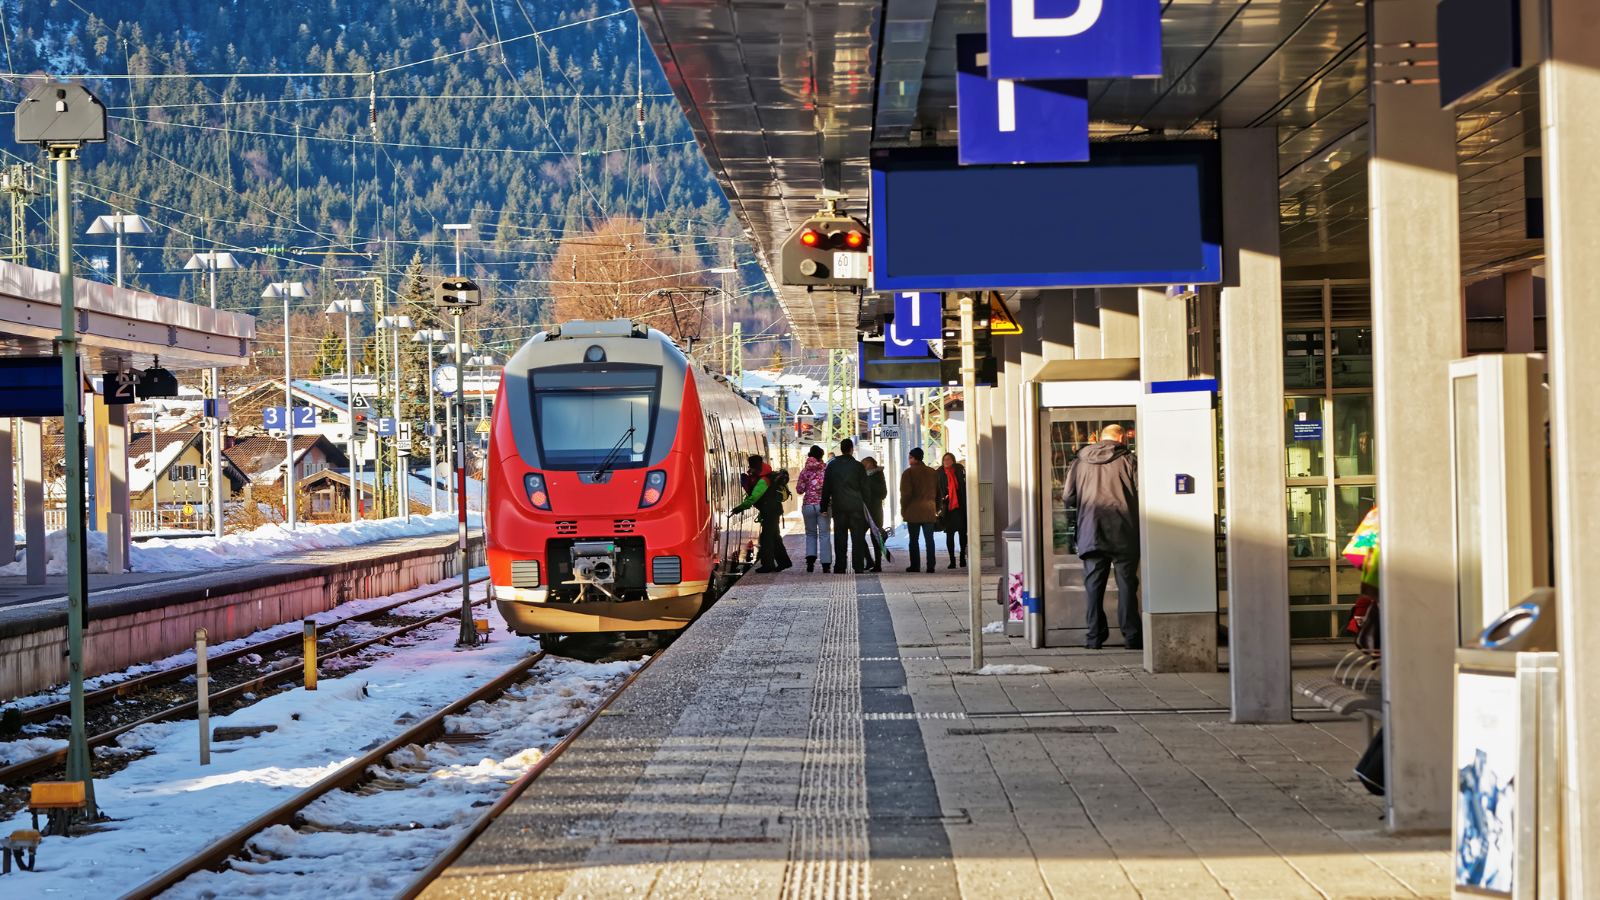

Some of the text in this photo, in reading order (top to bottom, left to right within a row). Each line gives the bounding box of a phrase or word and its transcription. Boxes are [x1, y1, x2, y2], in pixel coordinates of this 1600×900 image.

[838, 256, 848, 267] 60
[902, 291, 920, 327] 1
[115, 374, 130, 397] 2
[355, 397, 362, 407] 5
[266, 407, 278, 424] 3
[301, 406, 314, 424] 2
[801, 405, 809, 414] 5
[871, 407, 881, 421] E
[883, 403, 898, 425] H
[380, 418, 390, 432] E
[399, 423, 409, 440] H
[882, 429, 899, 438] 160m
[199, 468, 207, 480] H
